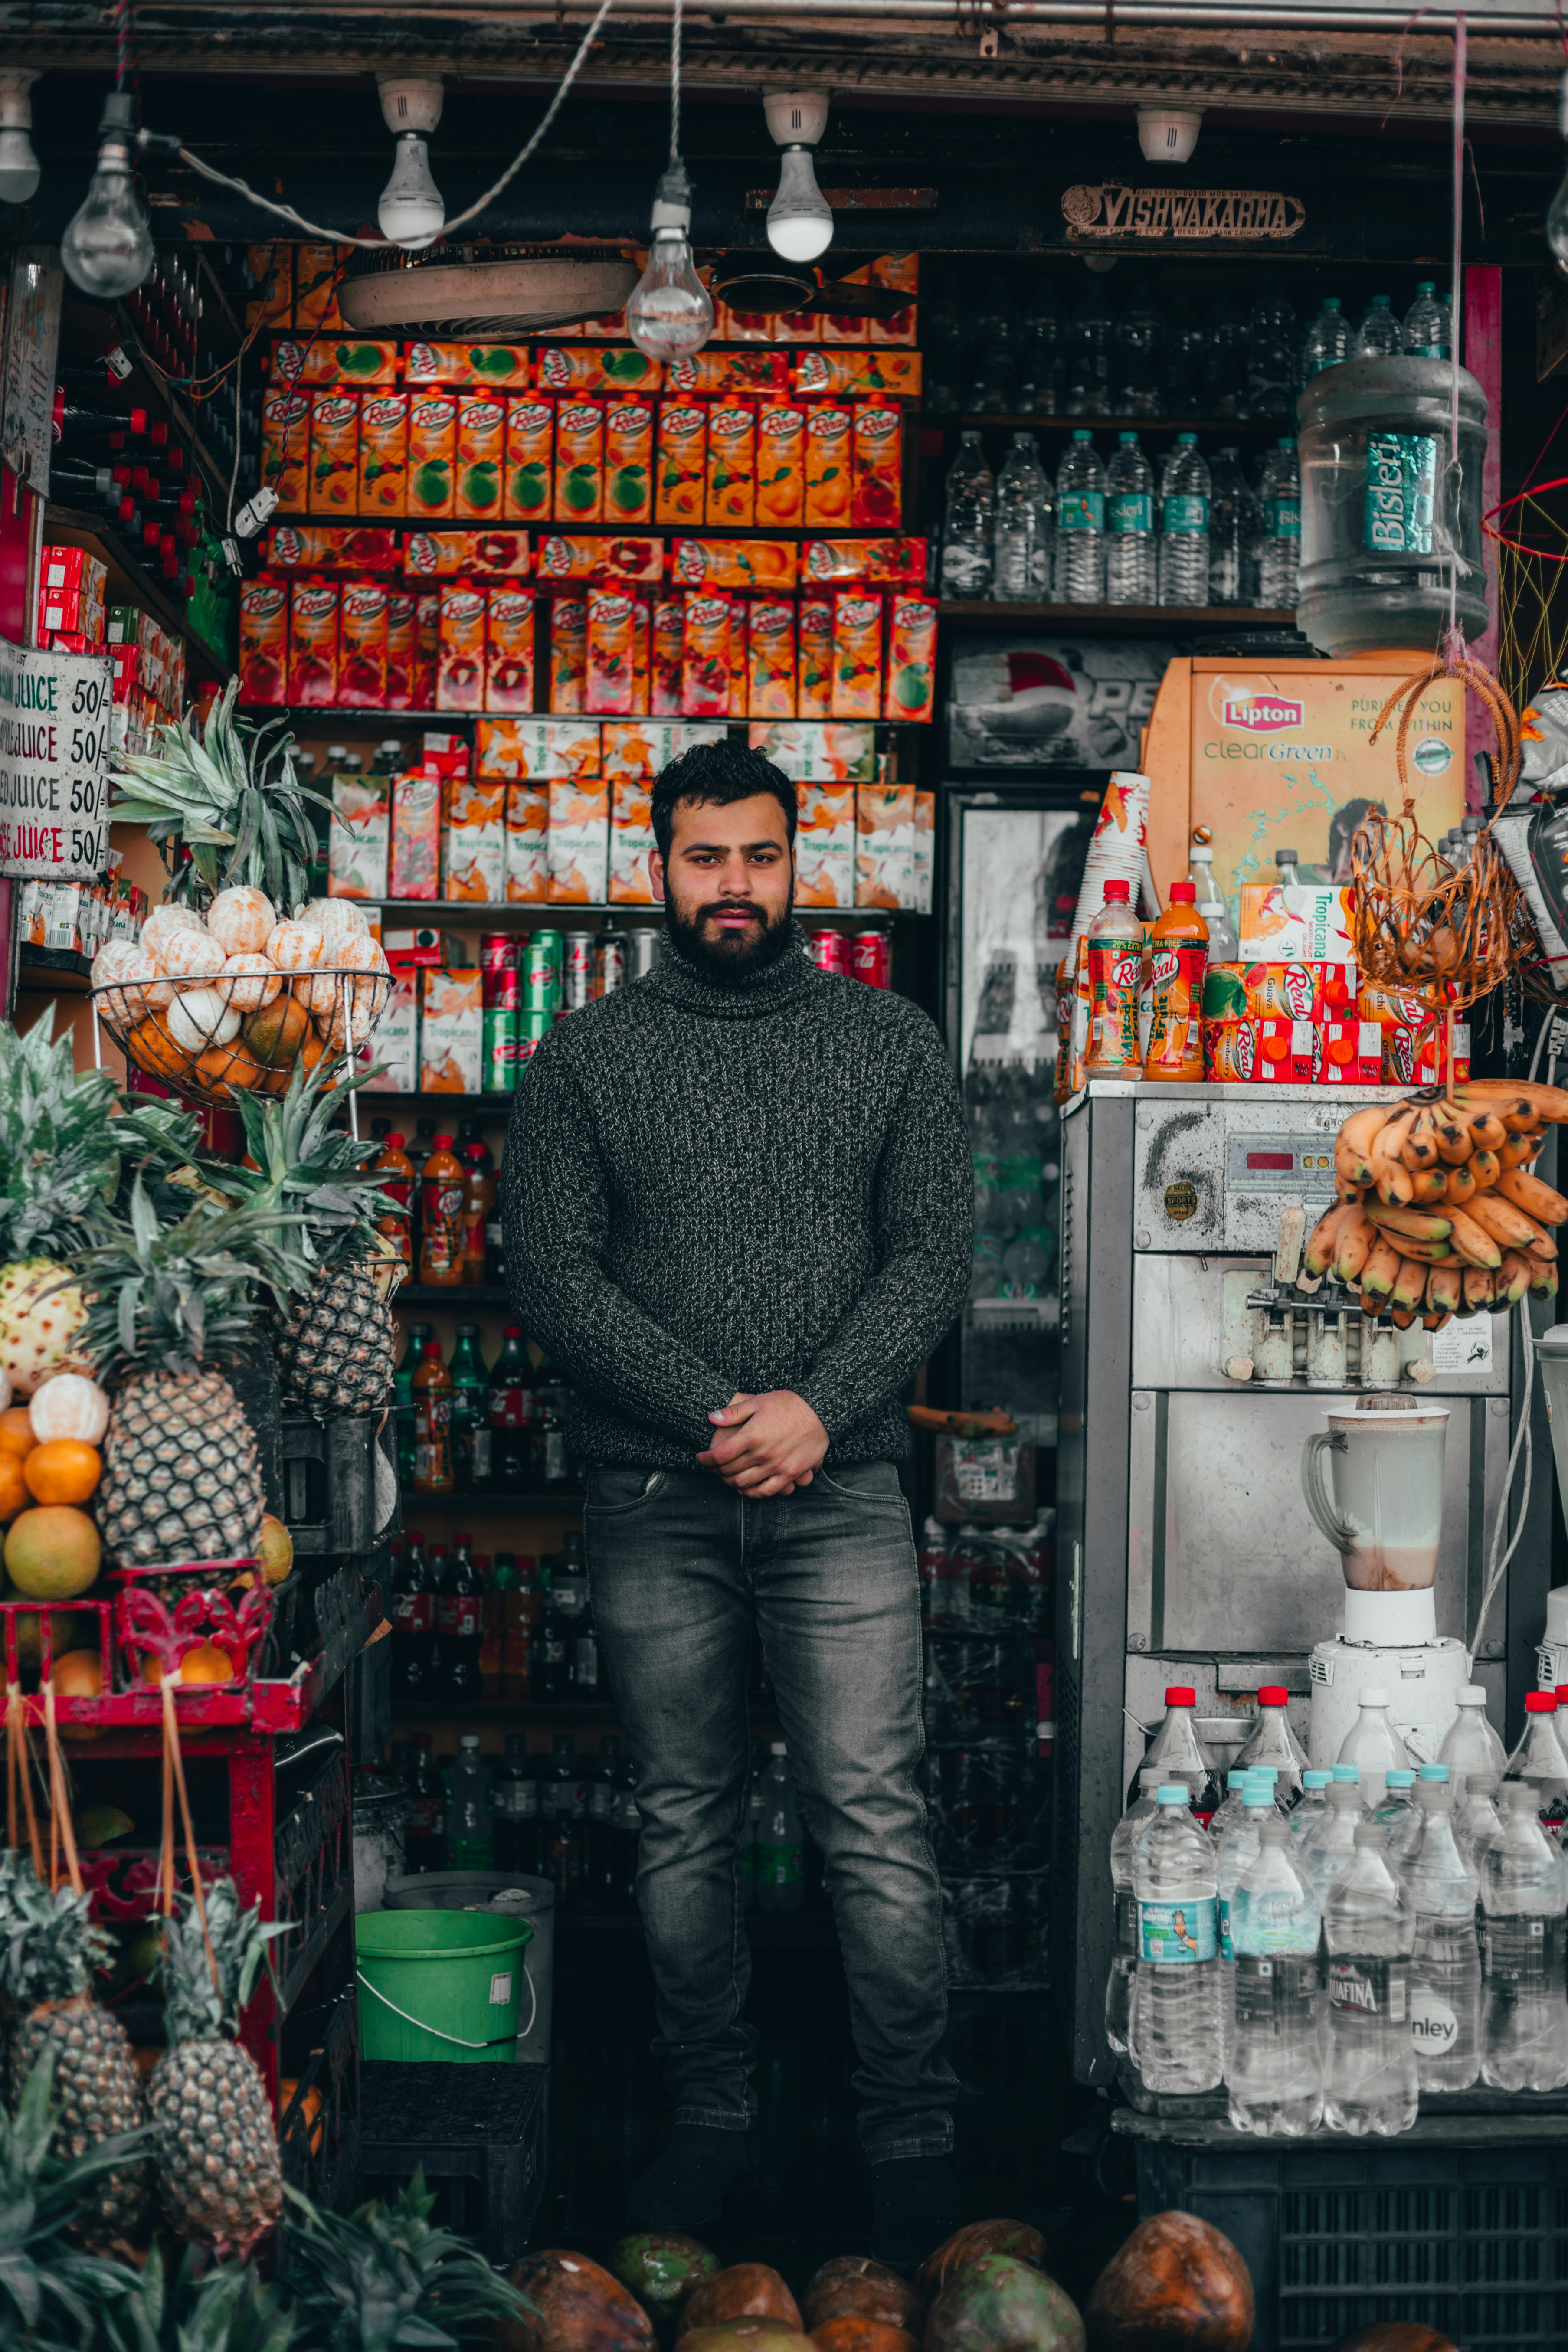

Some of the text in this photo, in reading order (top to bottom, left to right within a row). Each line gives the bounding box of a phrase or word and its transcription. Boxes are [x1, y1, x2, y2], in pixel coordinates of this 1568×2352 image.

[1105, 189, 1286, 228] VISHWAKARMA
[1370, 440, 1406, 546] Bisleri
[15, 674, 58, 713] JUICE
[72, 677, 109, 722] 50/=
[1230, 703, 1298, 726] Lipton
[1421, 700, 1451, 713] YOU
[1542, 702, 1568, 727] FLAVOUR
[15, 724, 59, 762] JUICE
[71, 725, 108, 771] 50/=
[11, 775, 61, 811] JUICE
[70, 776, 105, 820] 50/=
[13, 825, 105, 870] JUICE 50/=
[1112, 939, 1126, 949] 20%
[1152, 939, 1164, 948] XTRA
[1312, 892, 1333, 958] Tropicana
[1116, 962, 1143, 989] Rea
[1266, 978, 1276, 1009] Guava
[1283, 969, 1312, 1018] Real
[1120, 1004, 1133, 1058] Mixed
[1155, 995, 1168, 1040] Fruit
[1223, 1026, 1233, 1078] Cranberry
[1236, 1028, 1253, 1077] Real
[1391, 1033, 1414, 1081] Real
[1412, 2018, 1455, 2041] nley
